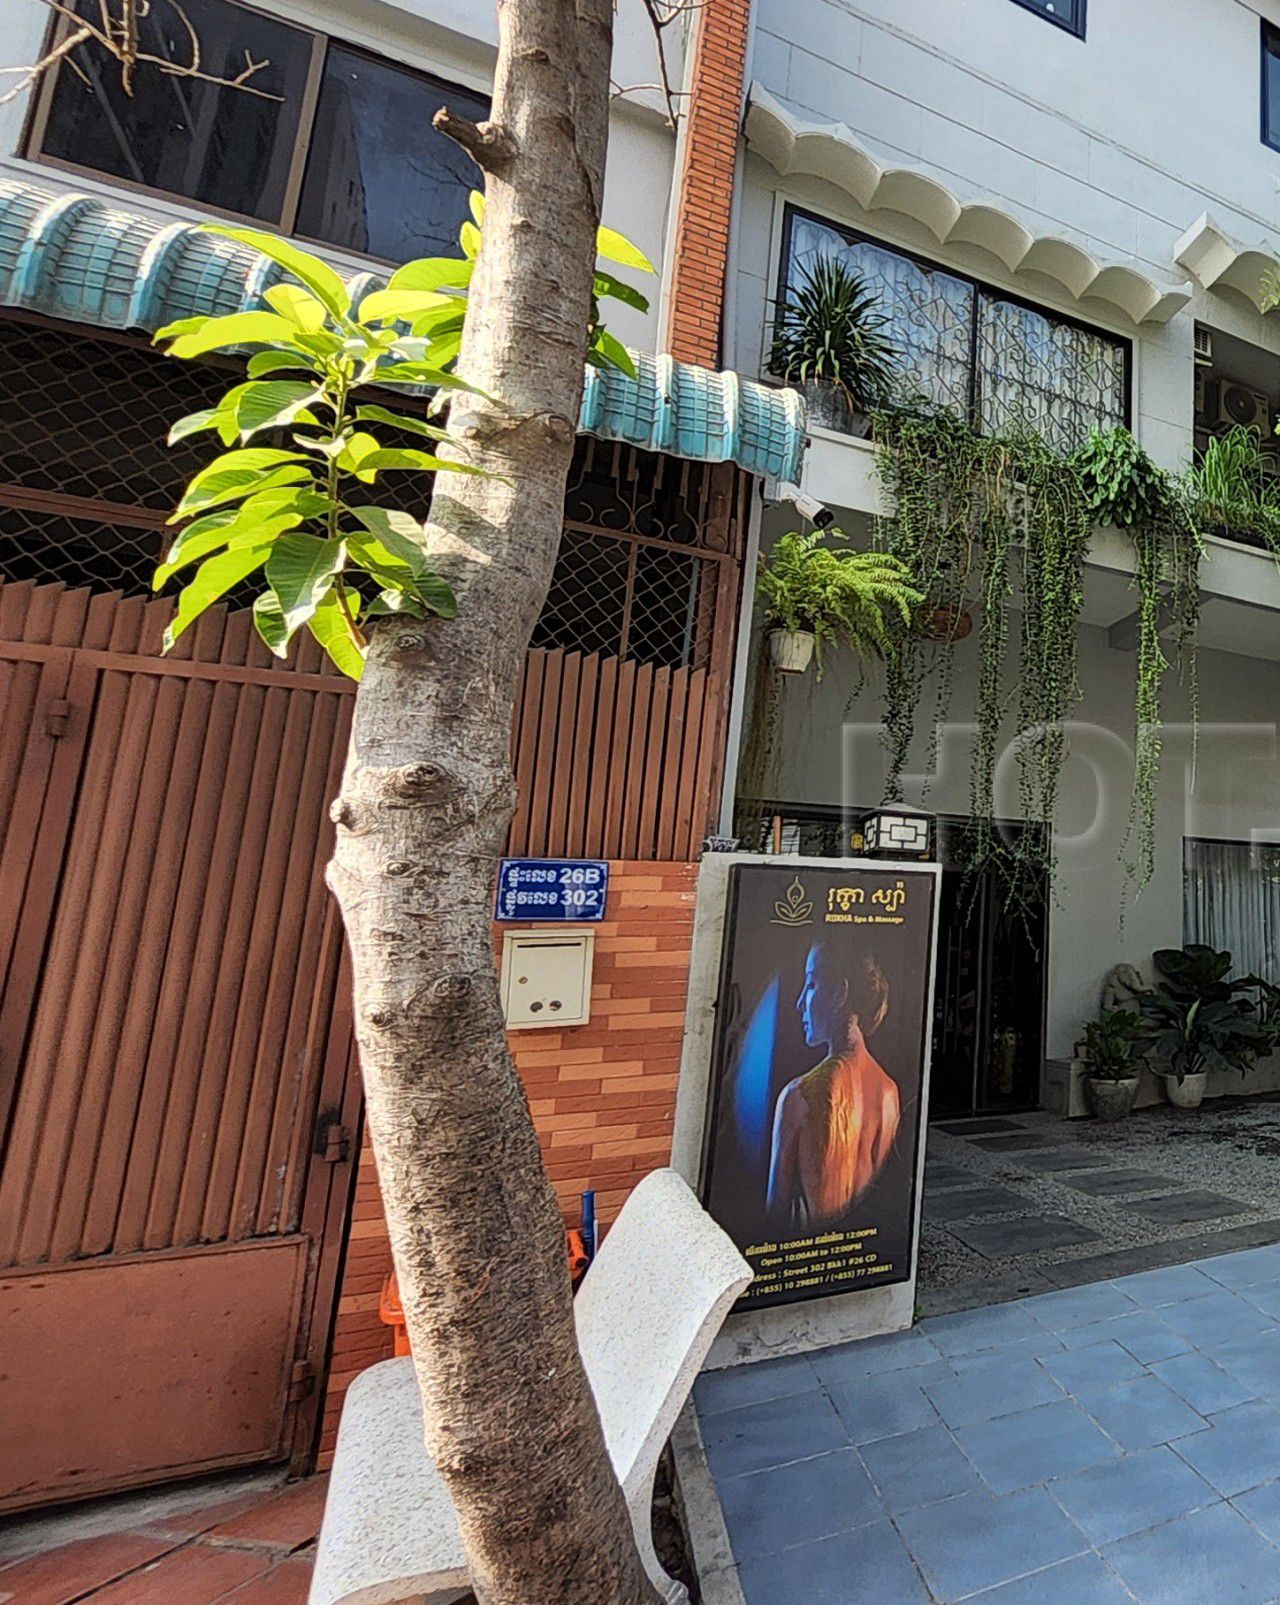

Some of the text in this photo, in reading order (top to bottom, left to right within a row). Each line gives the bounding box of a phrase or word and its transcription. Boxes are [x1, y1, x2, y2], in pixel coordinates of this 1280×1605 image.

[559, 868, 600, 884] 26B
[560, 890, 599, 905] 302
[853, 915, 867, 923] Spa
[874, 915, 904, 924] Massage
[780, 1238, 813, 1250] 10:00AM
[846, 1228, 877, 1239] 12:00PM
[761, 1257, 782, 1266] Open
[785, 1250, 818, 1262] 10:00AM
[831, 1242, 862, 1254] 12:00PM
[754, 1272, 776, 1283] dress
[783, 1266, 809, 1278] Street
[810, 1262, 825, 1272] 302
